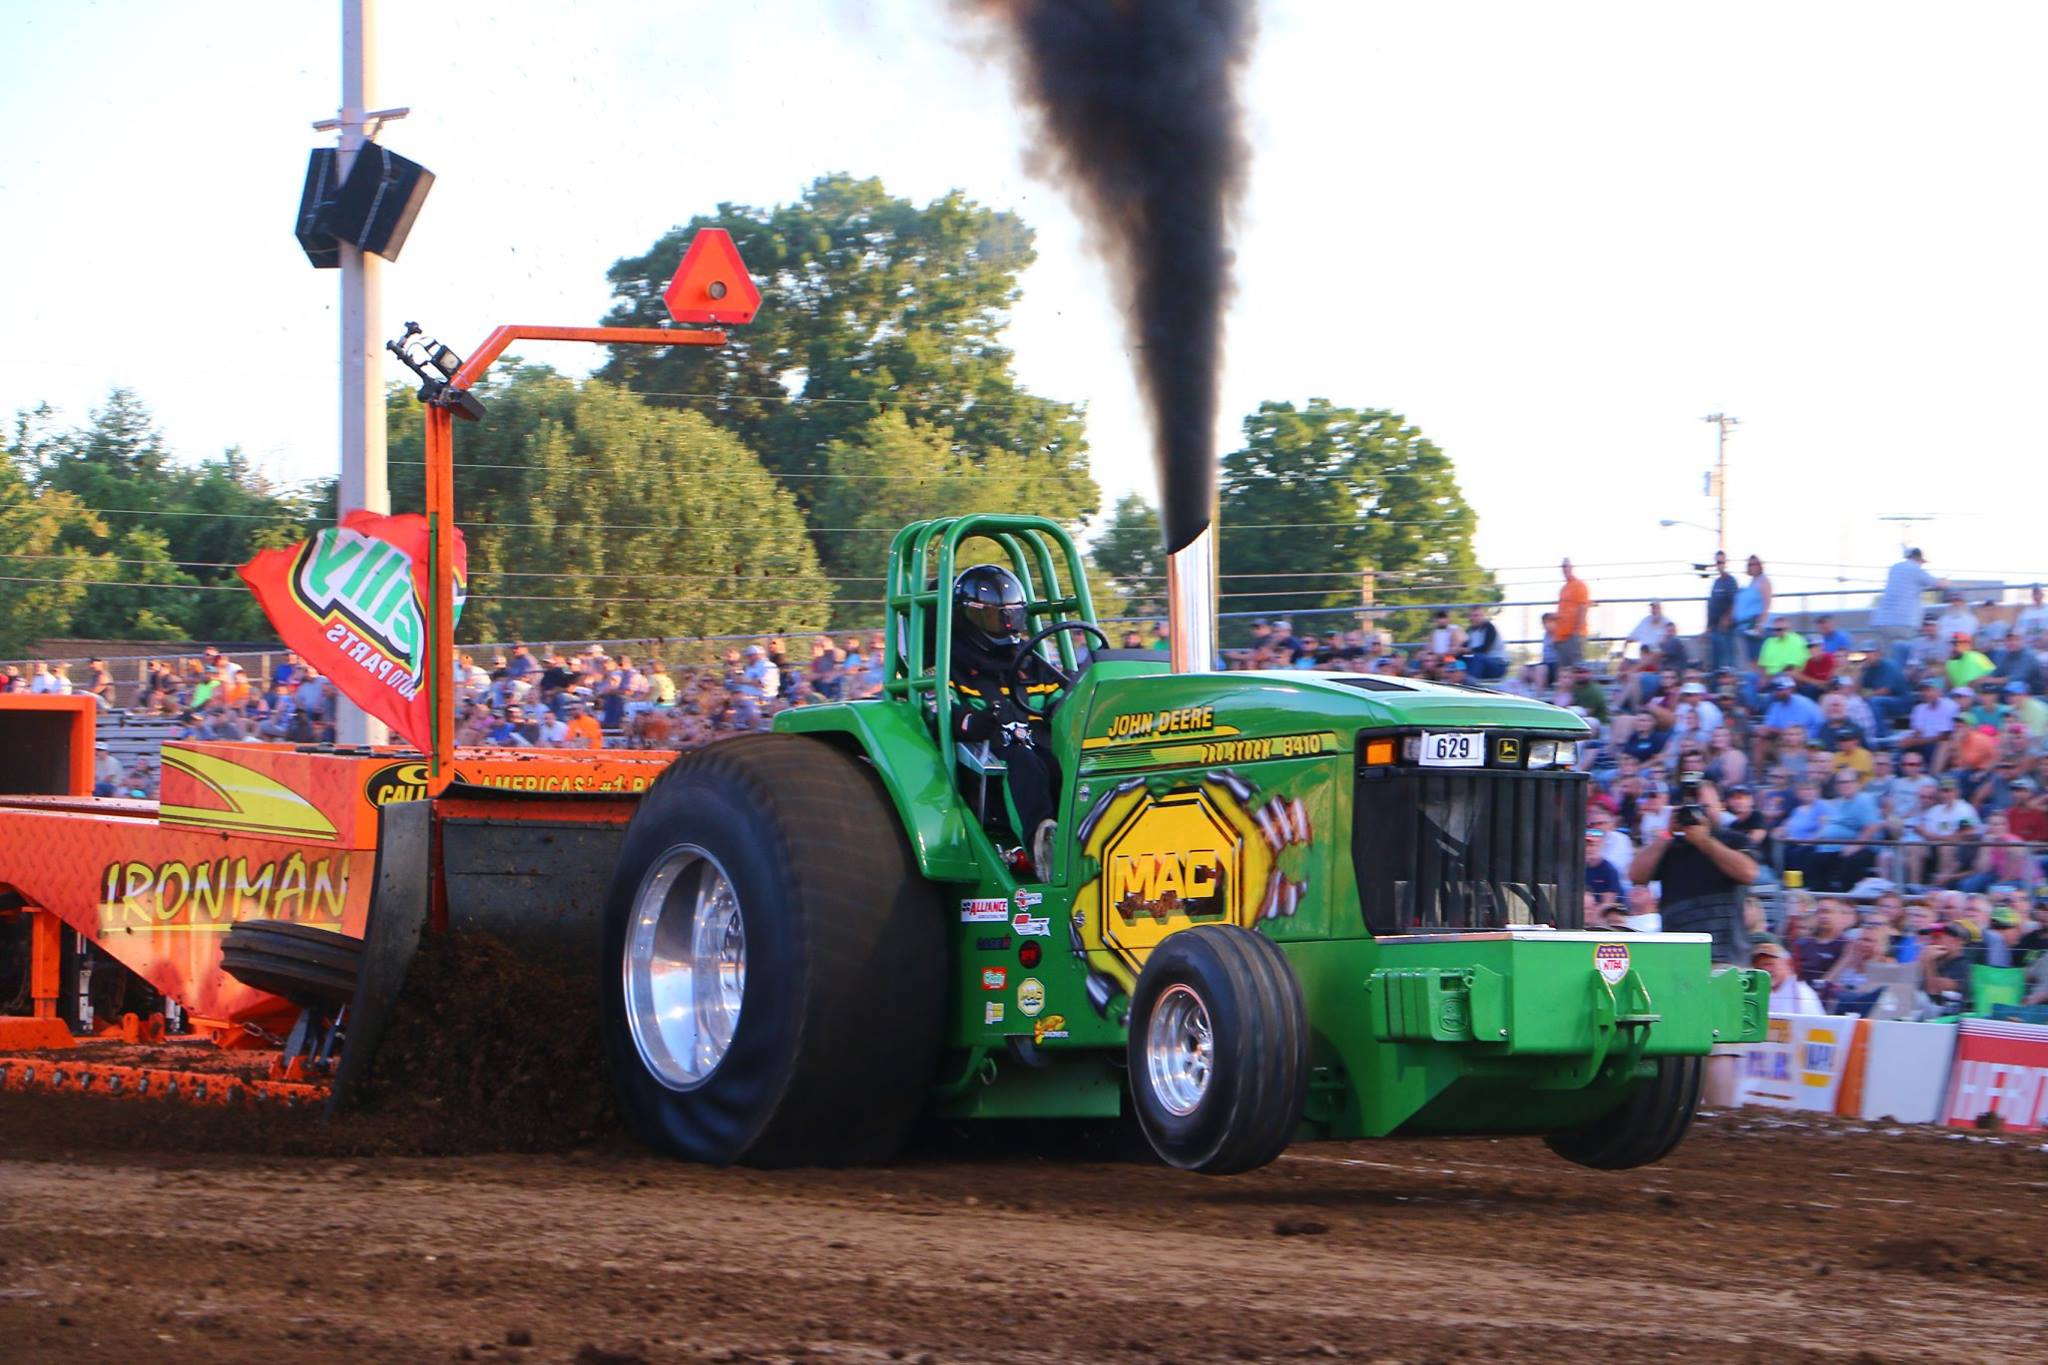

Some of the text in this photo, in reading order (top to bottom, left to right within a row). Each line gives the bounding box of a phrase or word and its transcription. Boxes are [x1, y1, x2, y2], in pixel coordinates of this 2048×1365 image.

[1108, 706, 1214, 737] JOHN DEERE
[1283, 734, 1321, 757] 8410
[1436, 737, 1470, 759] 629
[377, 784, 428, 805] CALL
[105, 851, 350, 922] IRONMAN
[1113, 848, 1219, 904] MAC
[970, 901, 1007, 916] ALLIANCE
